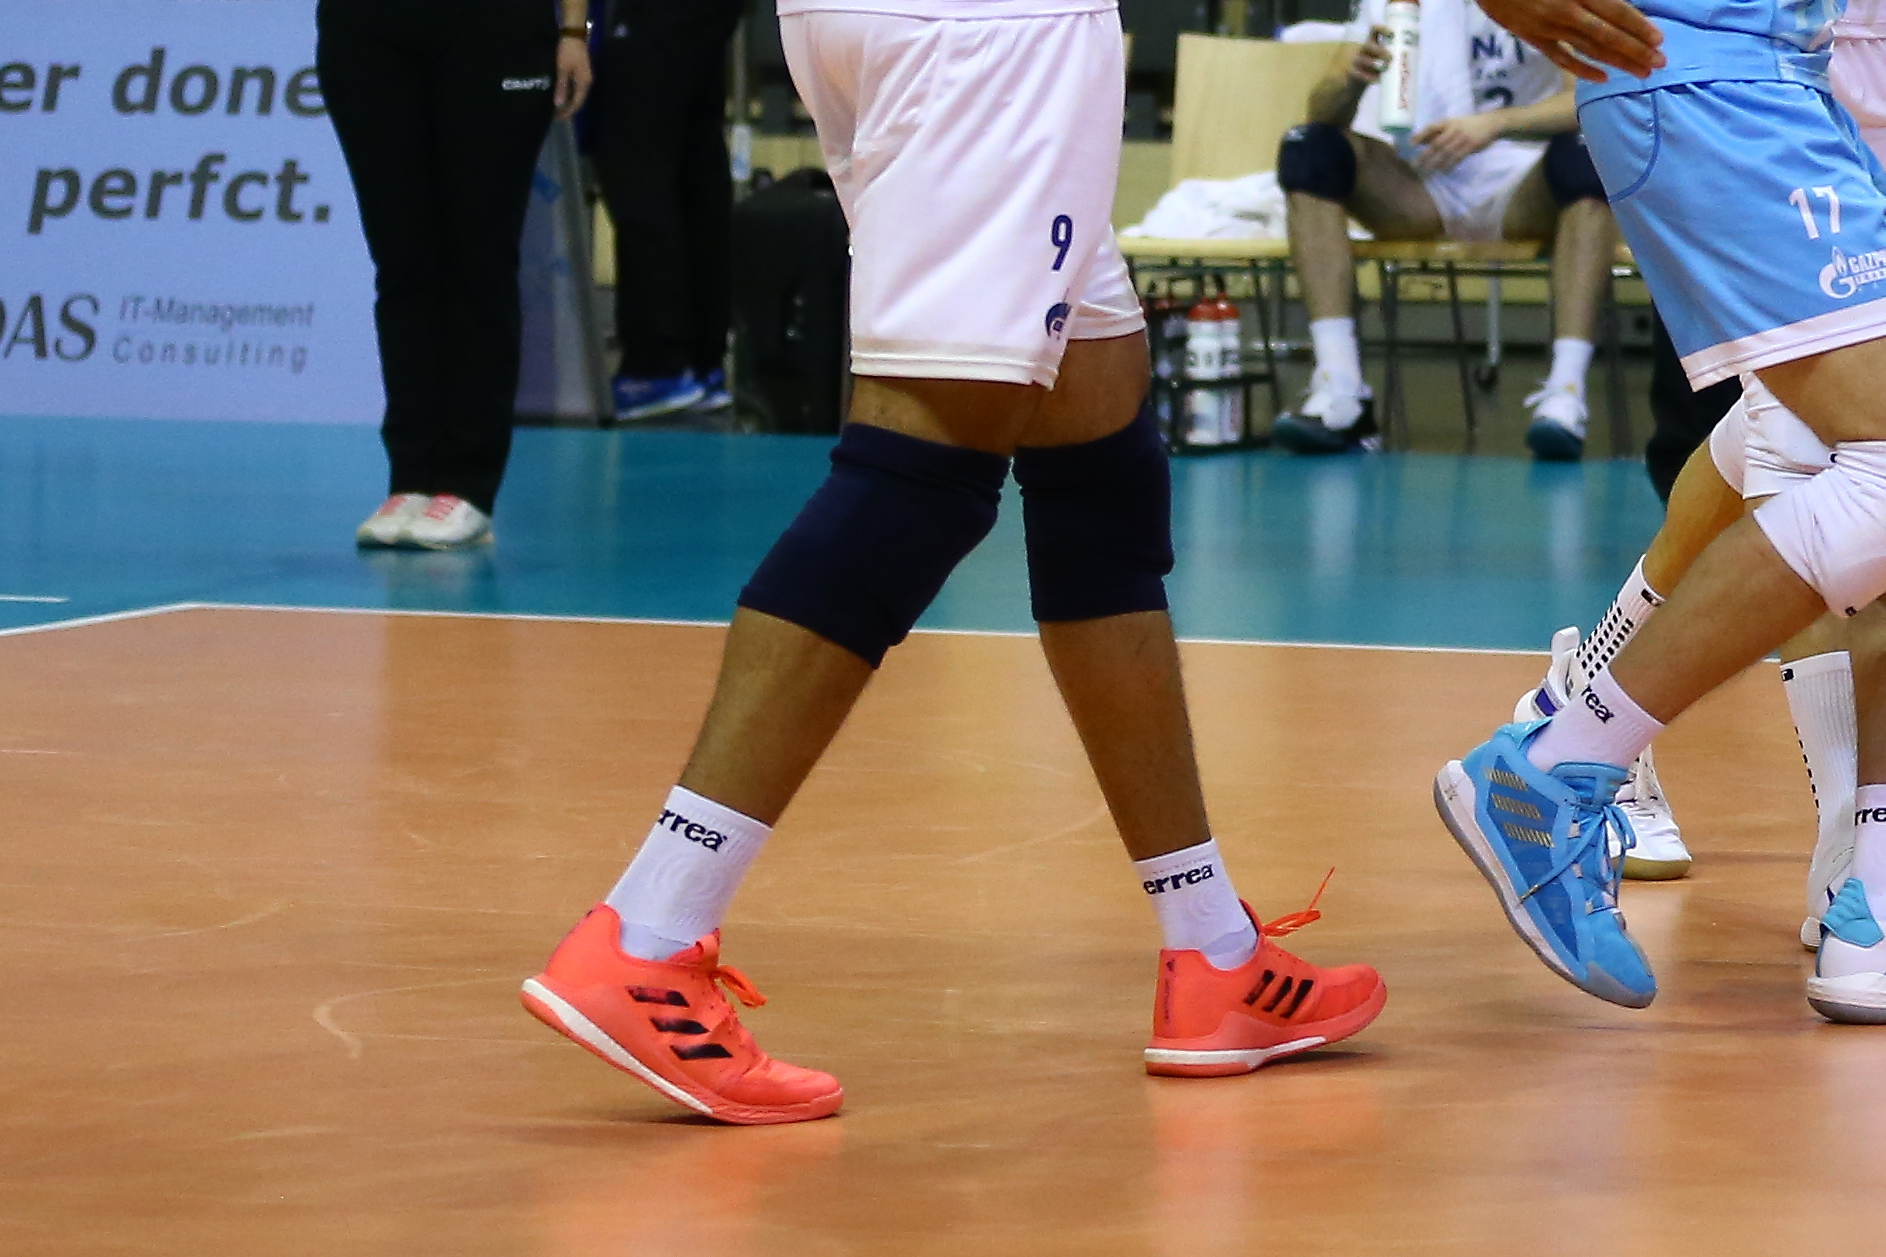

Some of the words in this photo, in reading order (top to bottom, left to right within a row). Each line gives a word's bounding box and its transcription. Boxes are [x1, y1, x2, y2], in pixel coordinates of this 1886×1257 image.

[112, 46, 326, 116] done
[27, 153, 332, 234] perfct.
[1788, 184, 1842, 240] 17
[1050, 213, 1074, 272] 9
[0, 292, 99, 362] AS
[112, 335, 309, 374] Consulting
